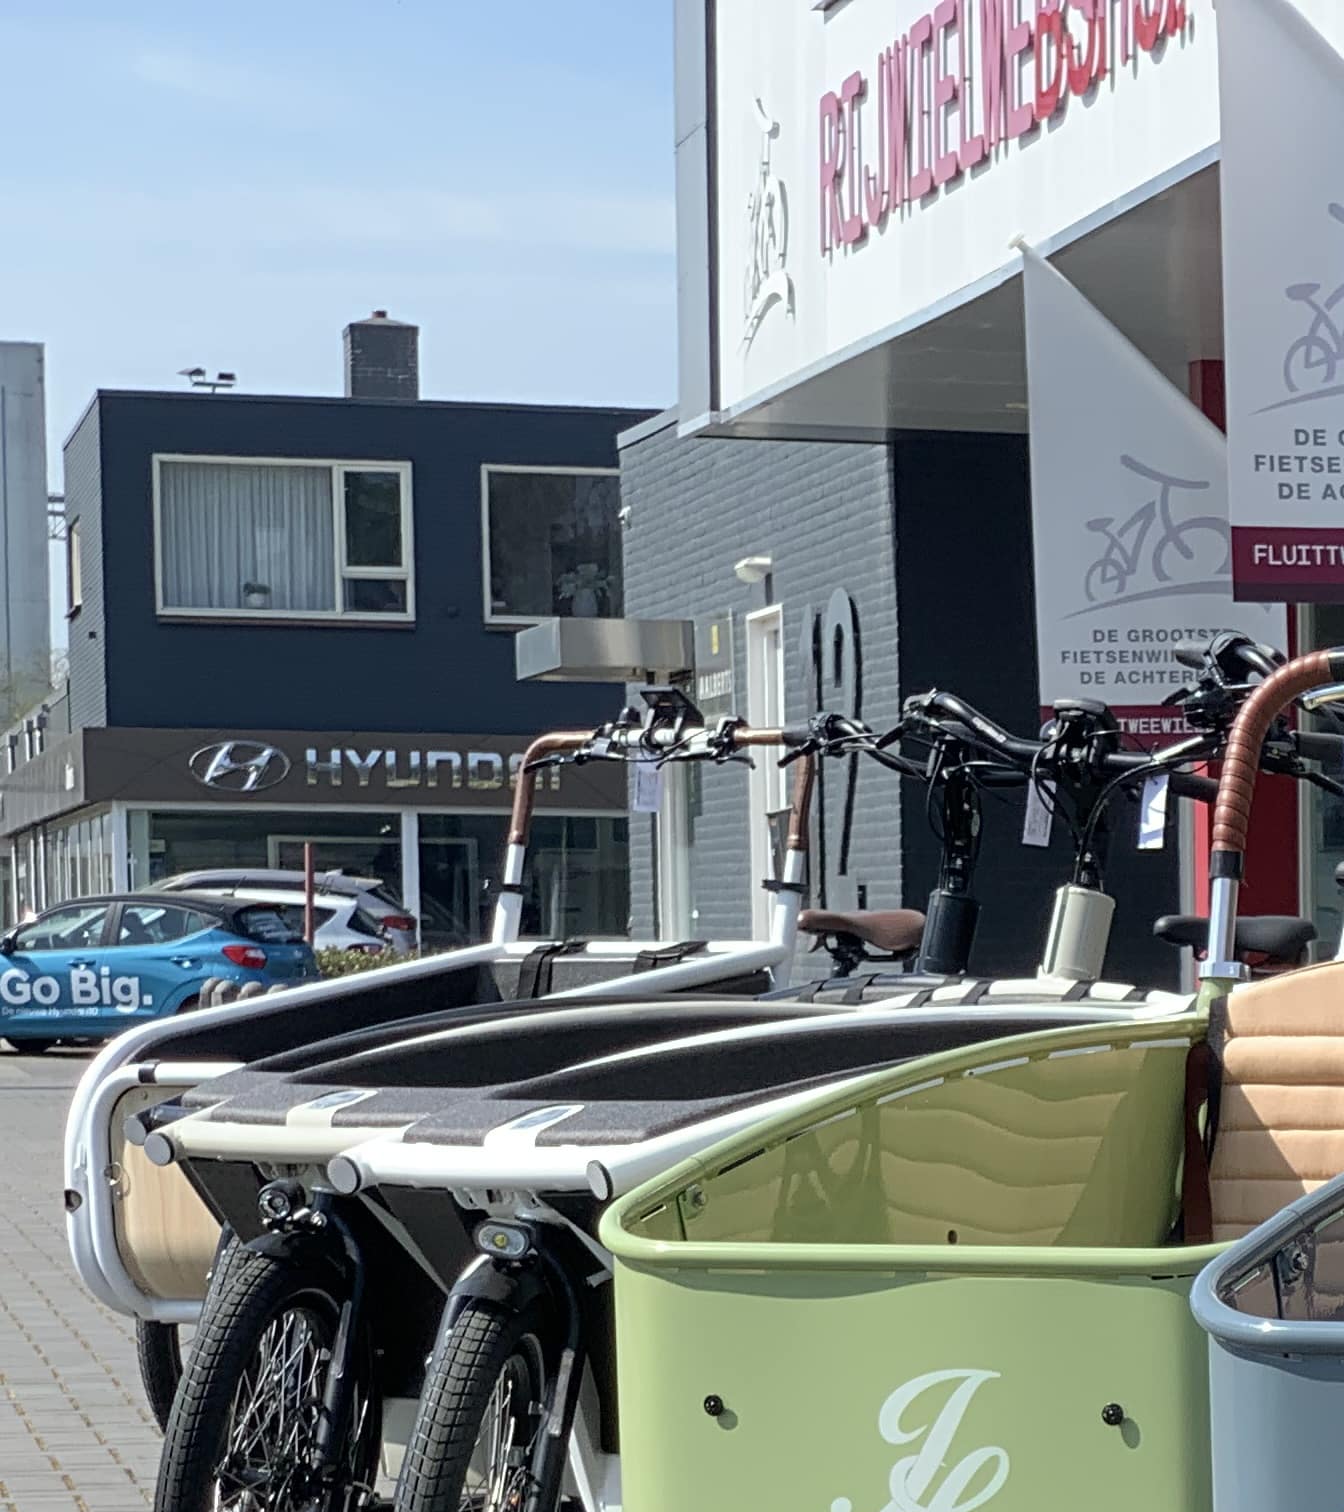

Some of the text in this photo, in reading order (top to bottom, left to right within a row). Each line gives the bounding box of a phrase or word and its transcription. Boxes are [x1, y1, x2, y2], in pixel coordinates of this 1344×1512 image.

[1294, 428, 1327, 447] DE
[1277, 482, 1311, 501] DE
[1092, 628, 1232, 643] DE GROOTST
[1079, 670, 1202, 685] DE ACHTER
[0, 966, 153, 1014] Go Big.
